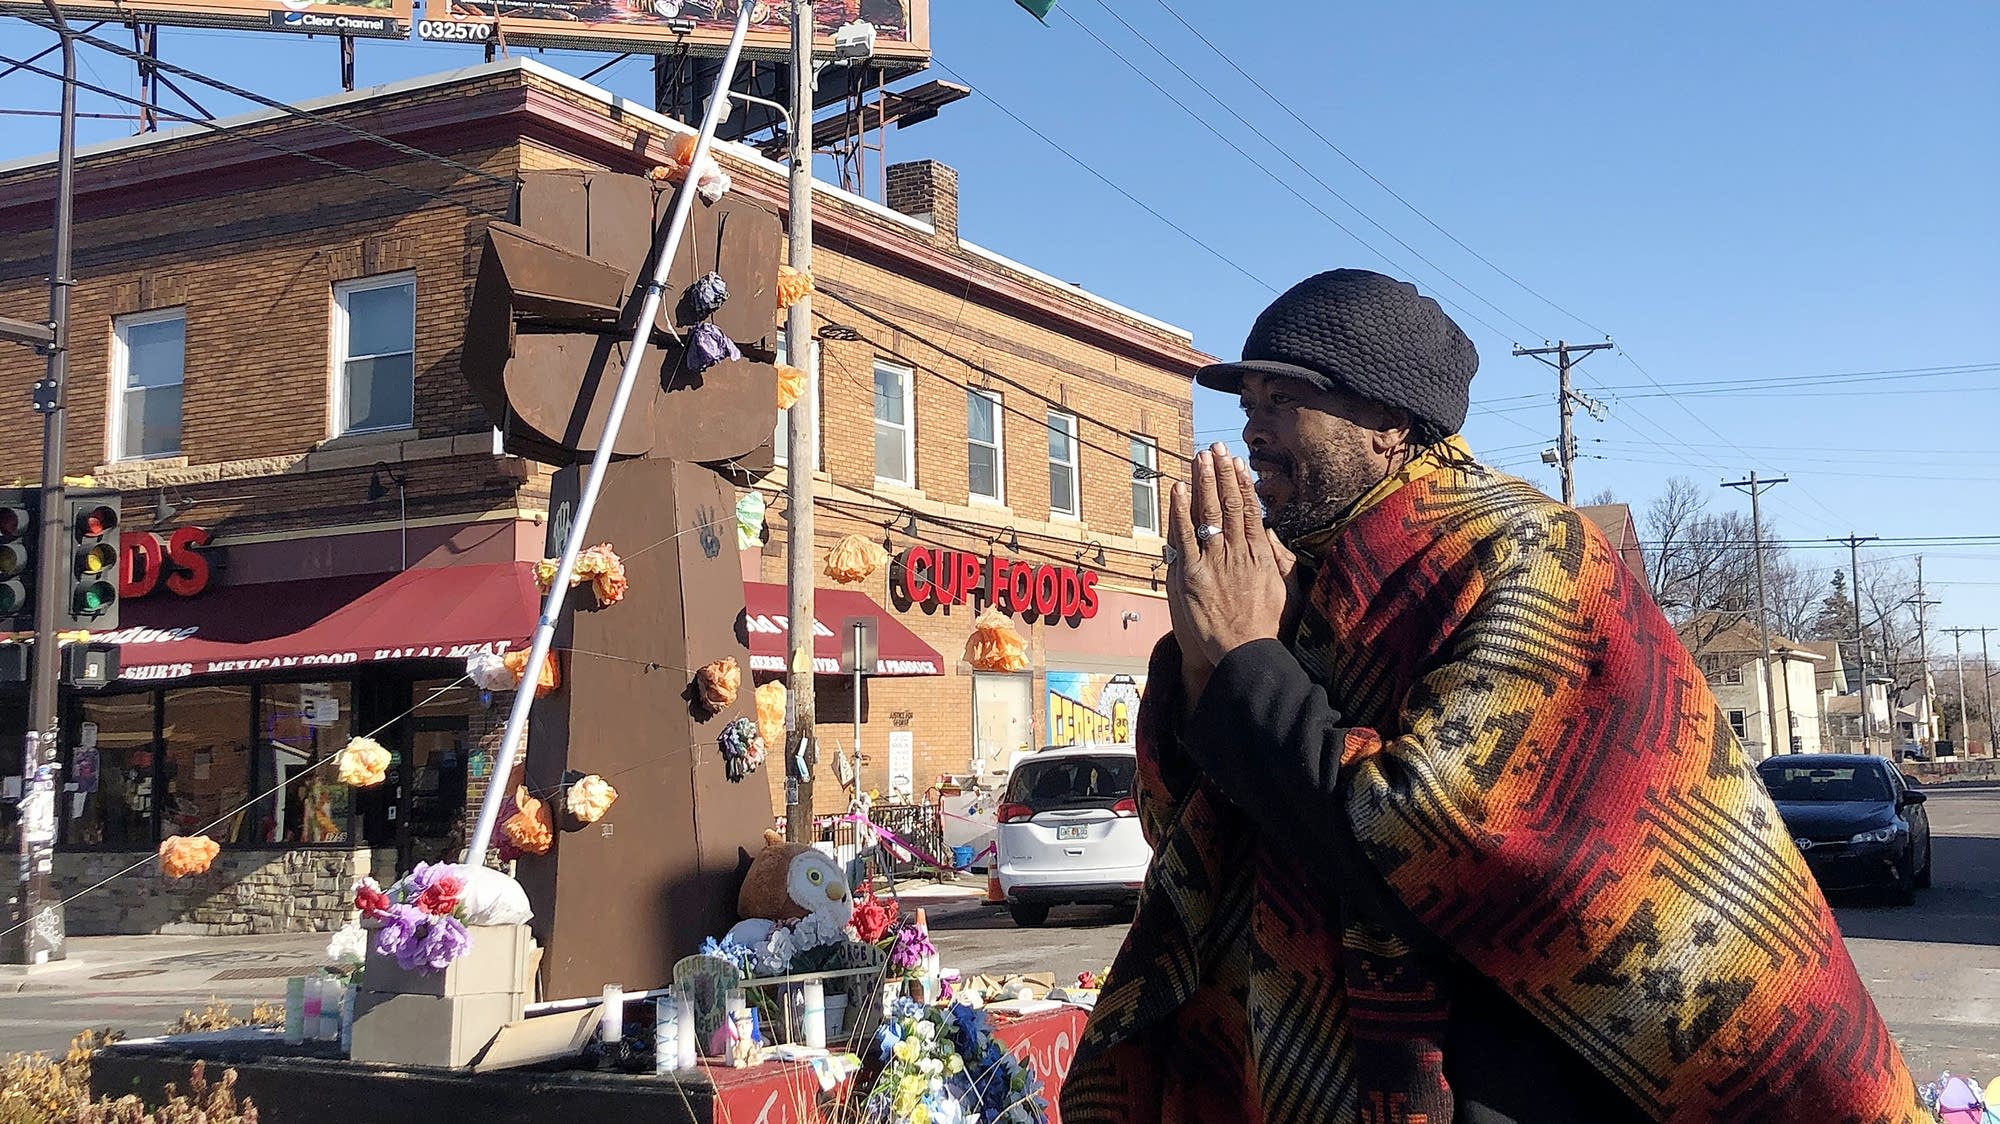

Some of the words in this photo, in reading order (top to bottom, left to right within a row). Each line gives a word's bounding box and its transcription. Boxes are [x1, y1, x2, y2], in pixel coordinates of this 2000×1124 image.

[302, 14, 335, 27] Clear
[335, 16, 384, 31] Channel
[418, 20, 490, 40] 032570
[906, 545, 980, 606] CUP
[992, 556, 1099, 619] FOODS
[887, 660, 937, 674] PRODUCE
